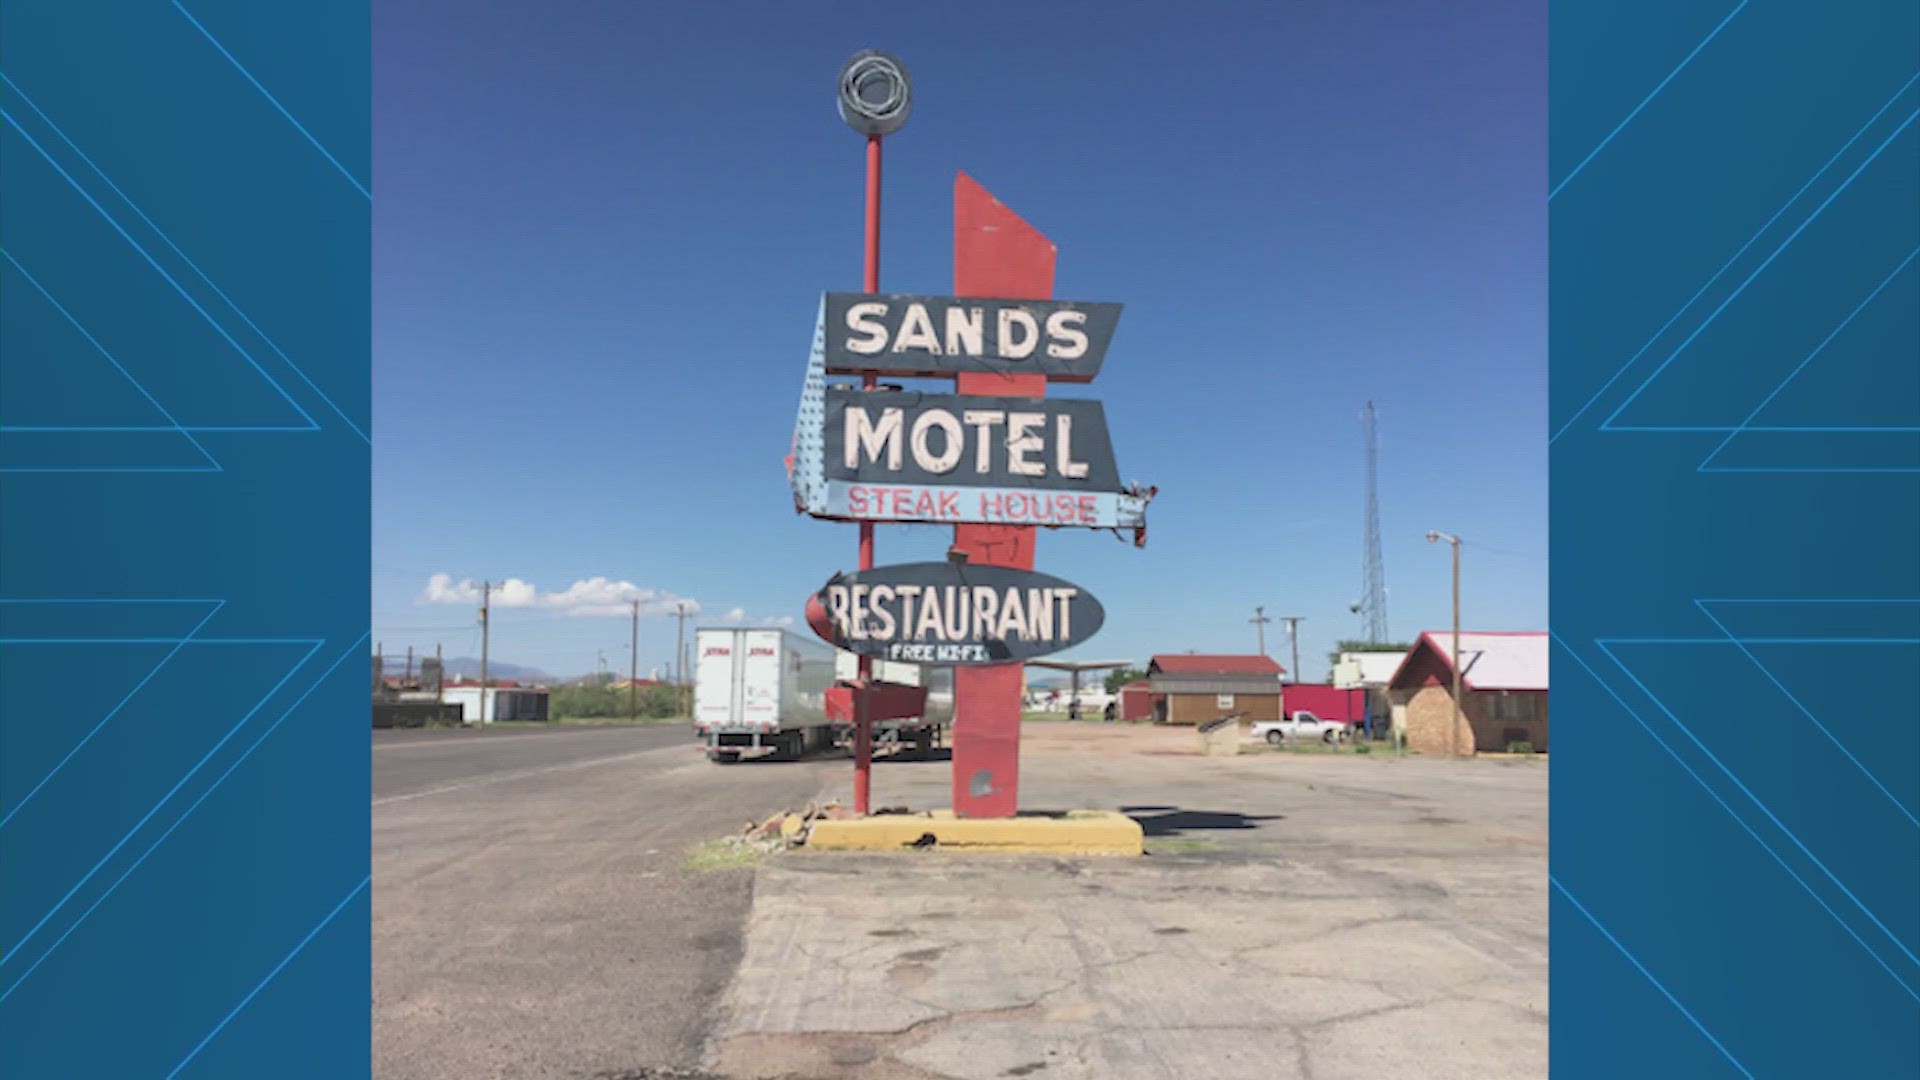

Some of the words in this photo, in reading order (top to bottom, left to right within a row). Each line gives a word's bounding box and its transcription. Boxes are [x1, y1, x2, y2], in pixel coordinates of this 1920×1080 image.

[845, 303, 1090, 359] SANDS
[844, 406, 1089, 478] MOTEL
[848, 487, 961, 517] STEAK
[979, 491, 1098, 523] HOUSE
[829, 584, 1077, 642] RESTAURANT
[890, 643, 936, 661] FREE
